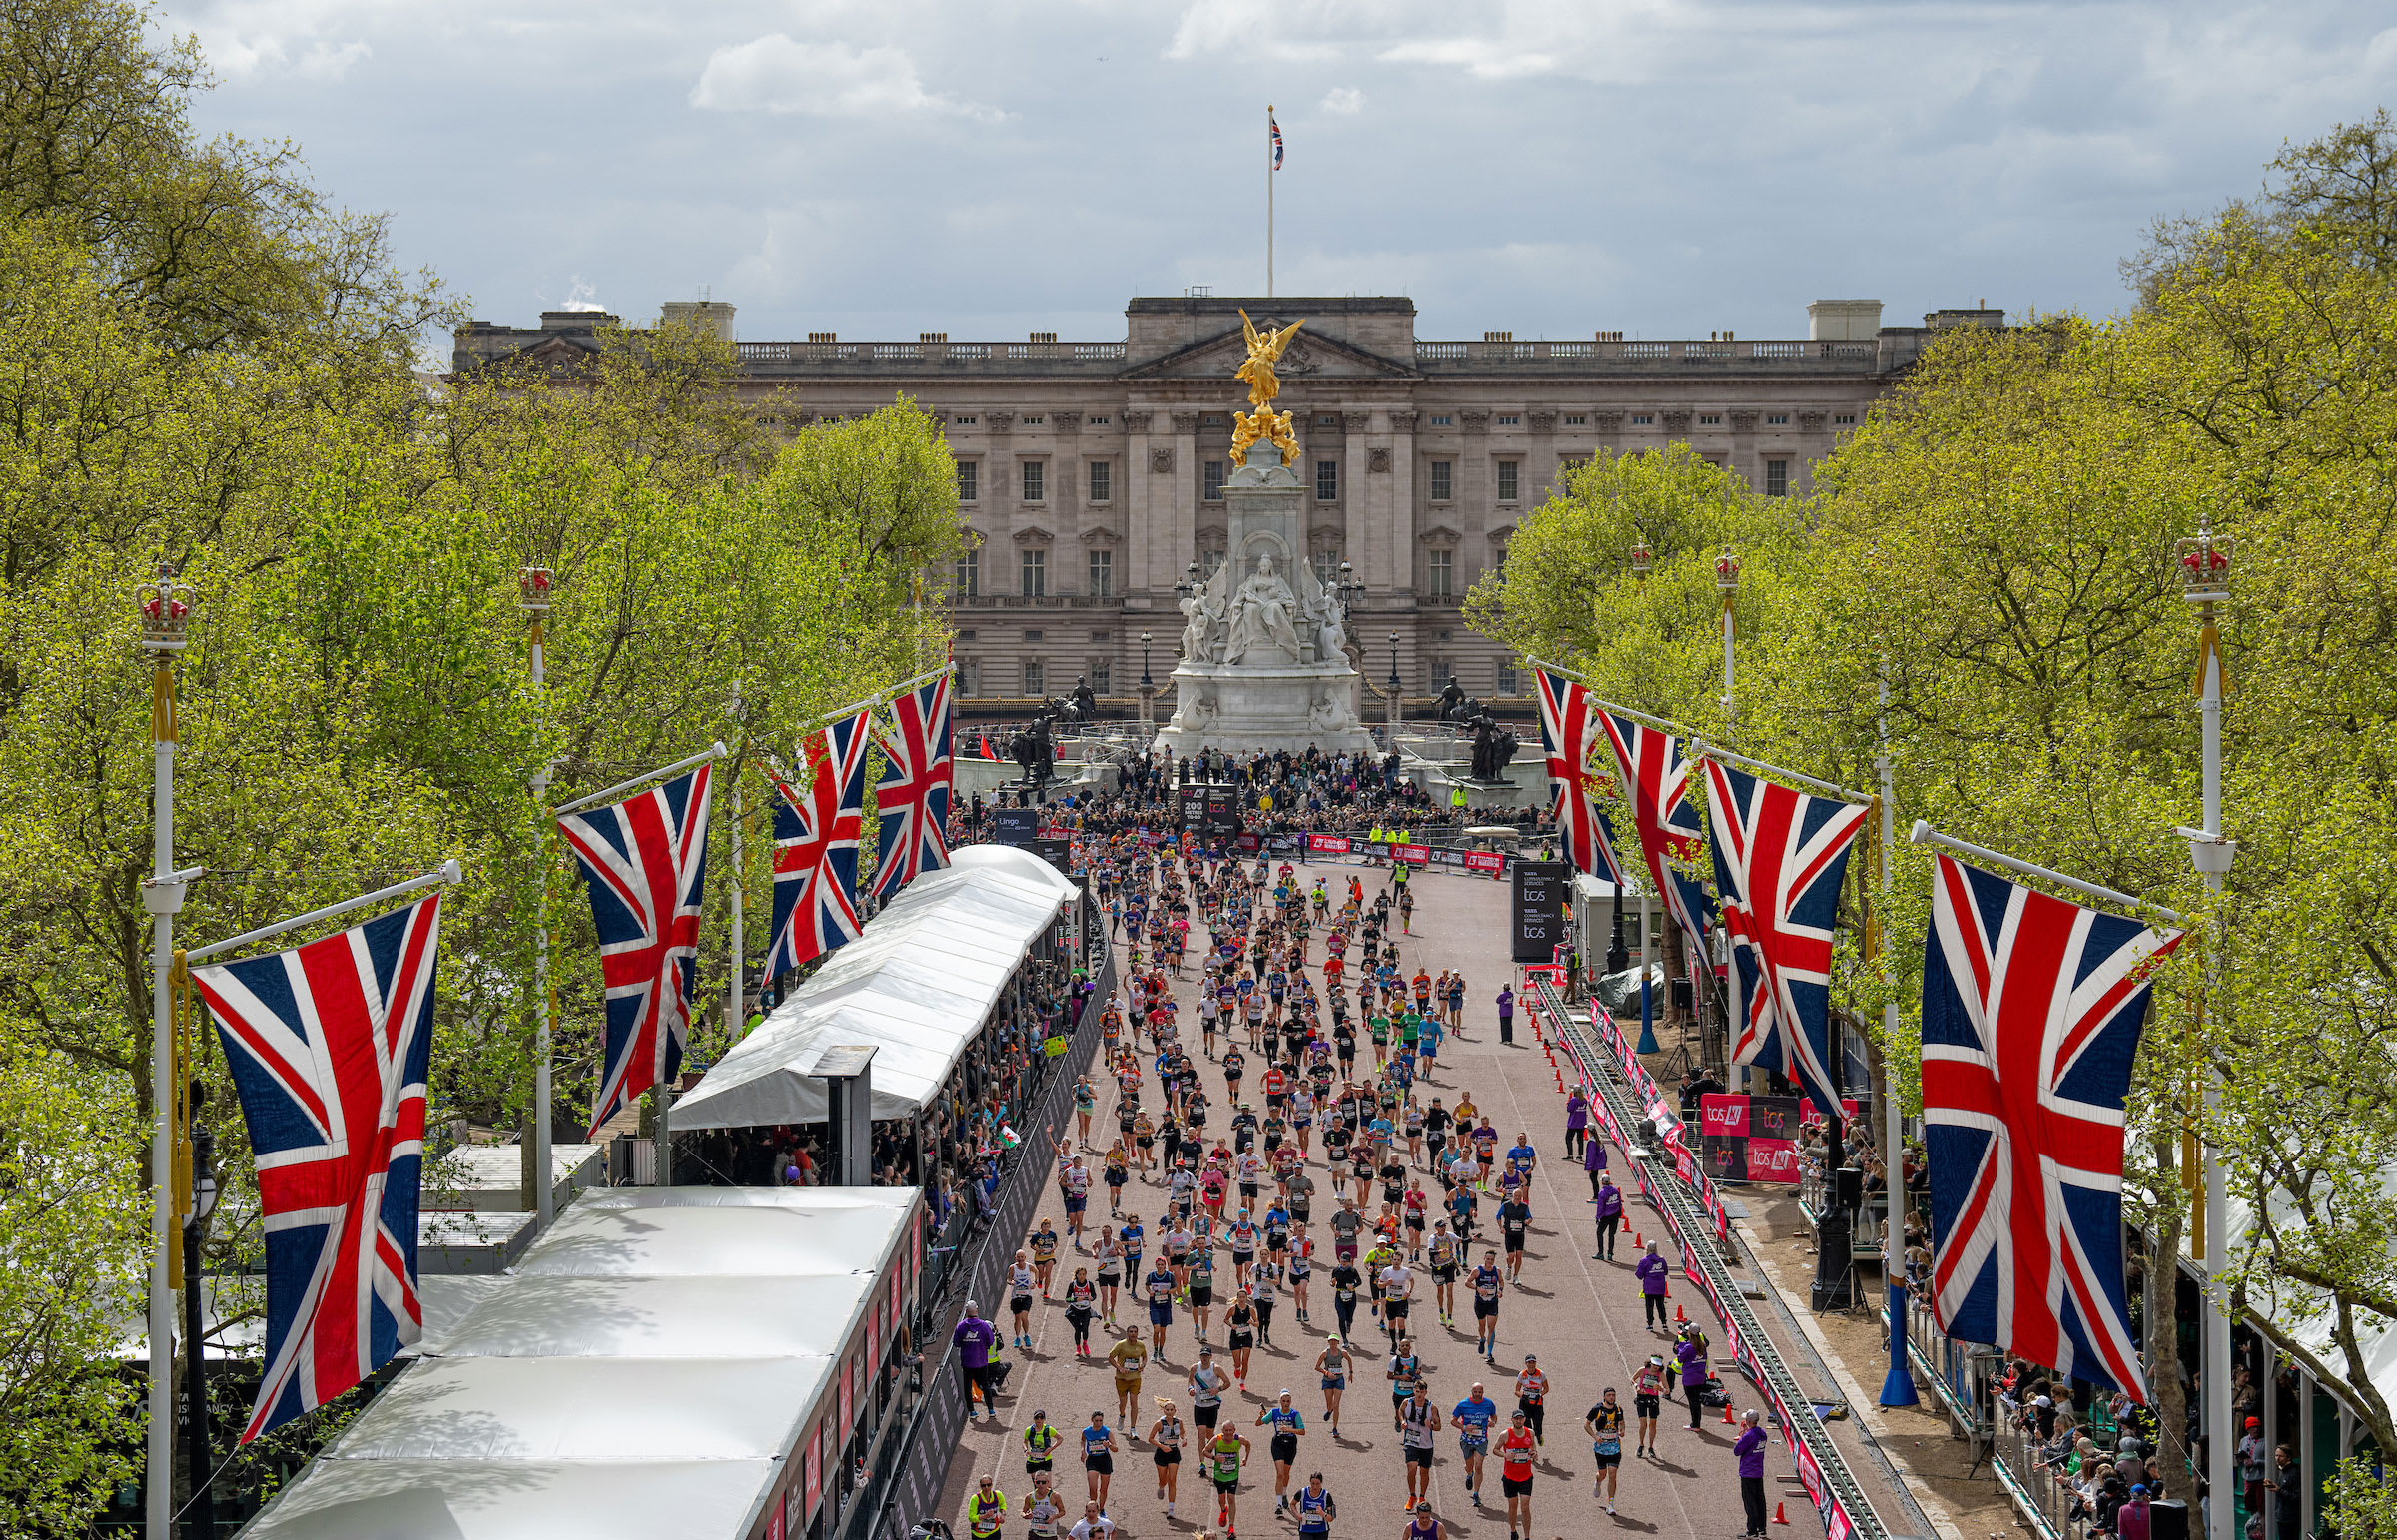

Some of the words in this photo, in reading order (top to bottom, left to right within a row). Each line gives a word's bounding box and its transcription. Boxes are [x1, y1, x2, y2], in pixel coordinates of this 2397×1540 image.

[1209, 802, 1226, 813] tcs
[1524, 887, 1545, 901] tcs
[1524, 924, 1545, 938] tcs
[1707, 1105, 1724, 1122] tcs
[1764, 1107, 1785, 1129] tcs
[1807, 1109, 1821, 1126] tc
[1716, 1145, 1733, 1166] tcs
[1753, 1149, 1769, 1166] tcs
